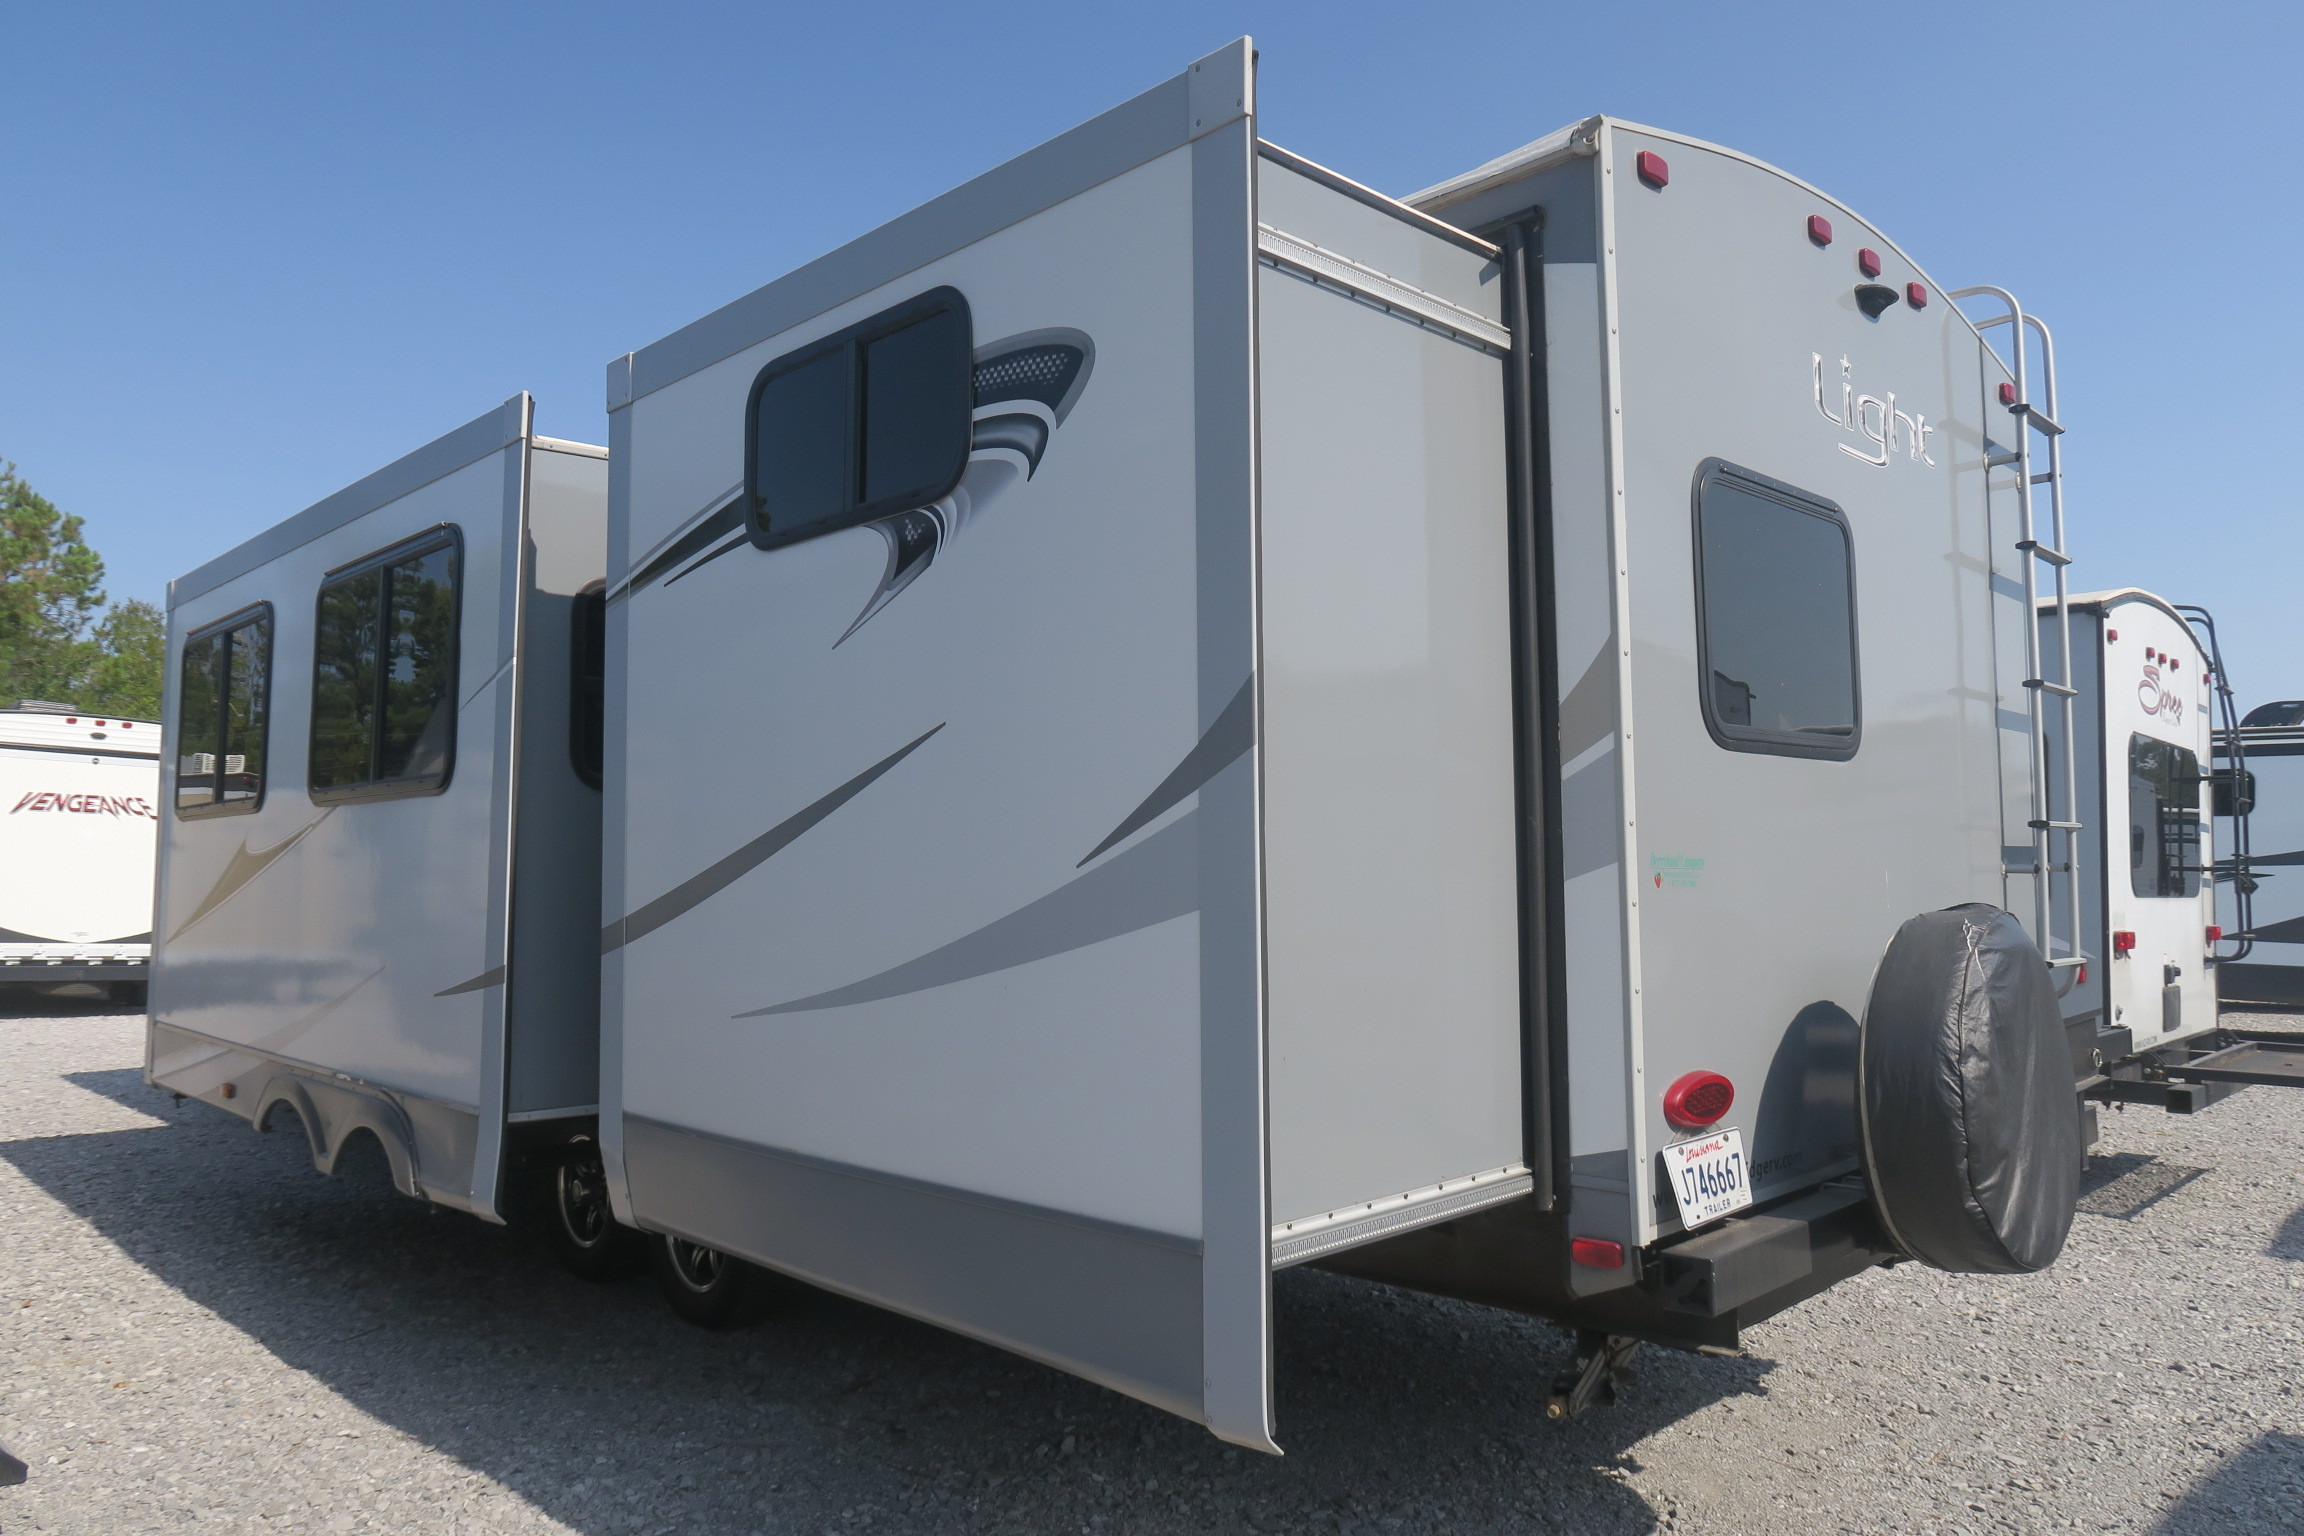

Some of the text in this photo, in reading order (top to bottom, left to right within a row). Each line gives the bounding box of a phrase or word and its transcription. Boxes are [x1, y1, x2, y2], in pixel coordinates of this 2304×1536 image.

[1812, 352, 1935, 469] Light
[2138, 664, 2183, 726] Spree
[9, 791, 158, 821] VENGEANCE
[1686, 1139, 1724, 1163] Louisiana
[1681, 1152, 1742, 1206] J746667
[1704, 1198, 1732, 1215] TRAILER
